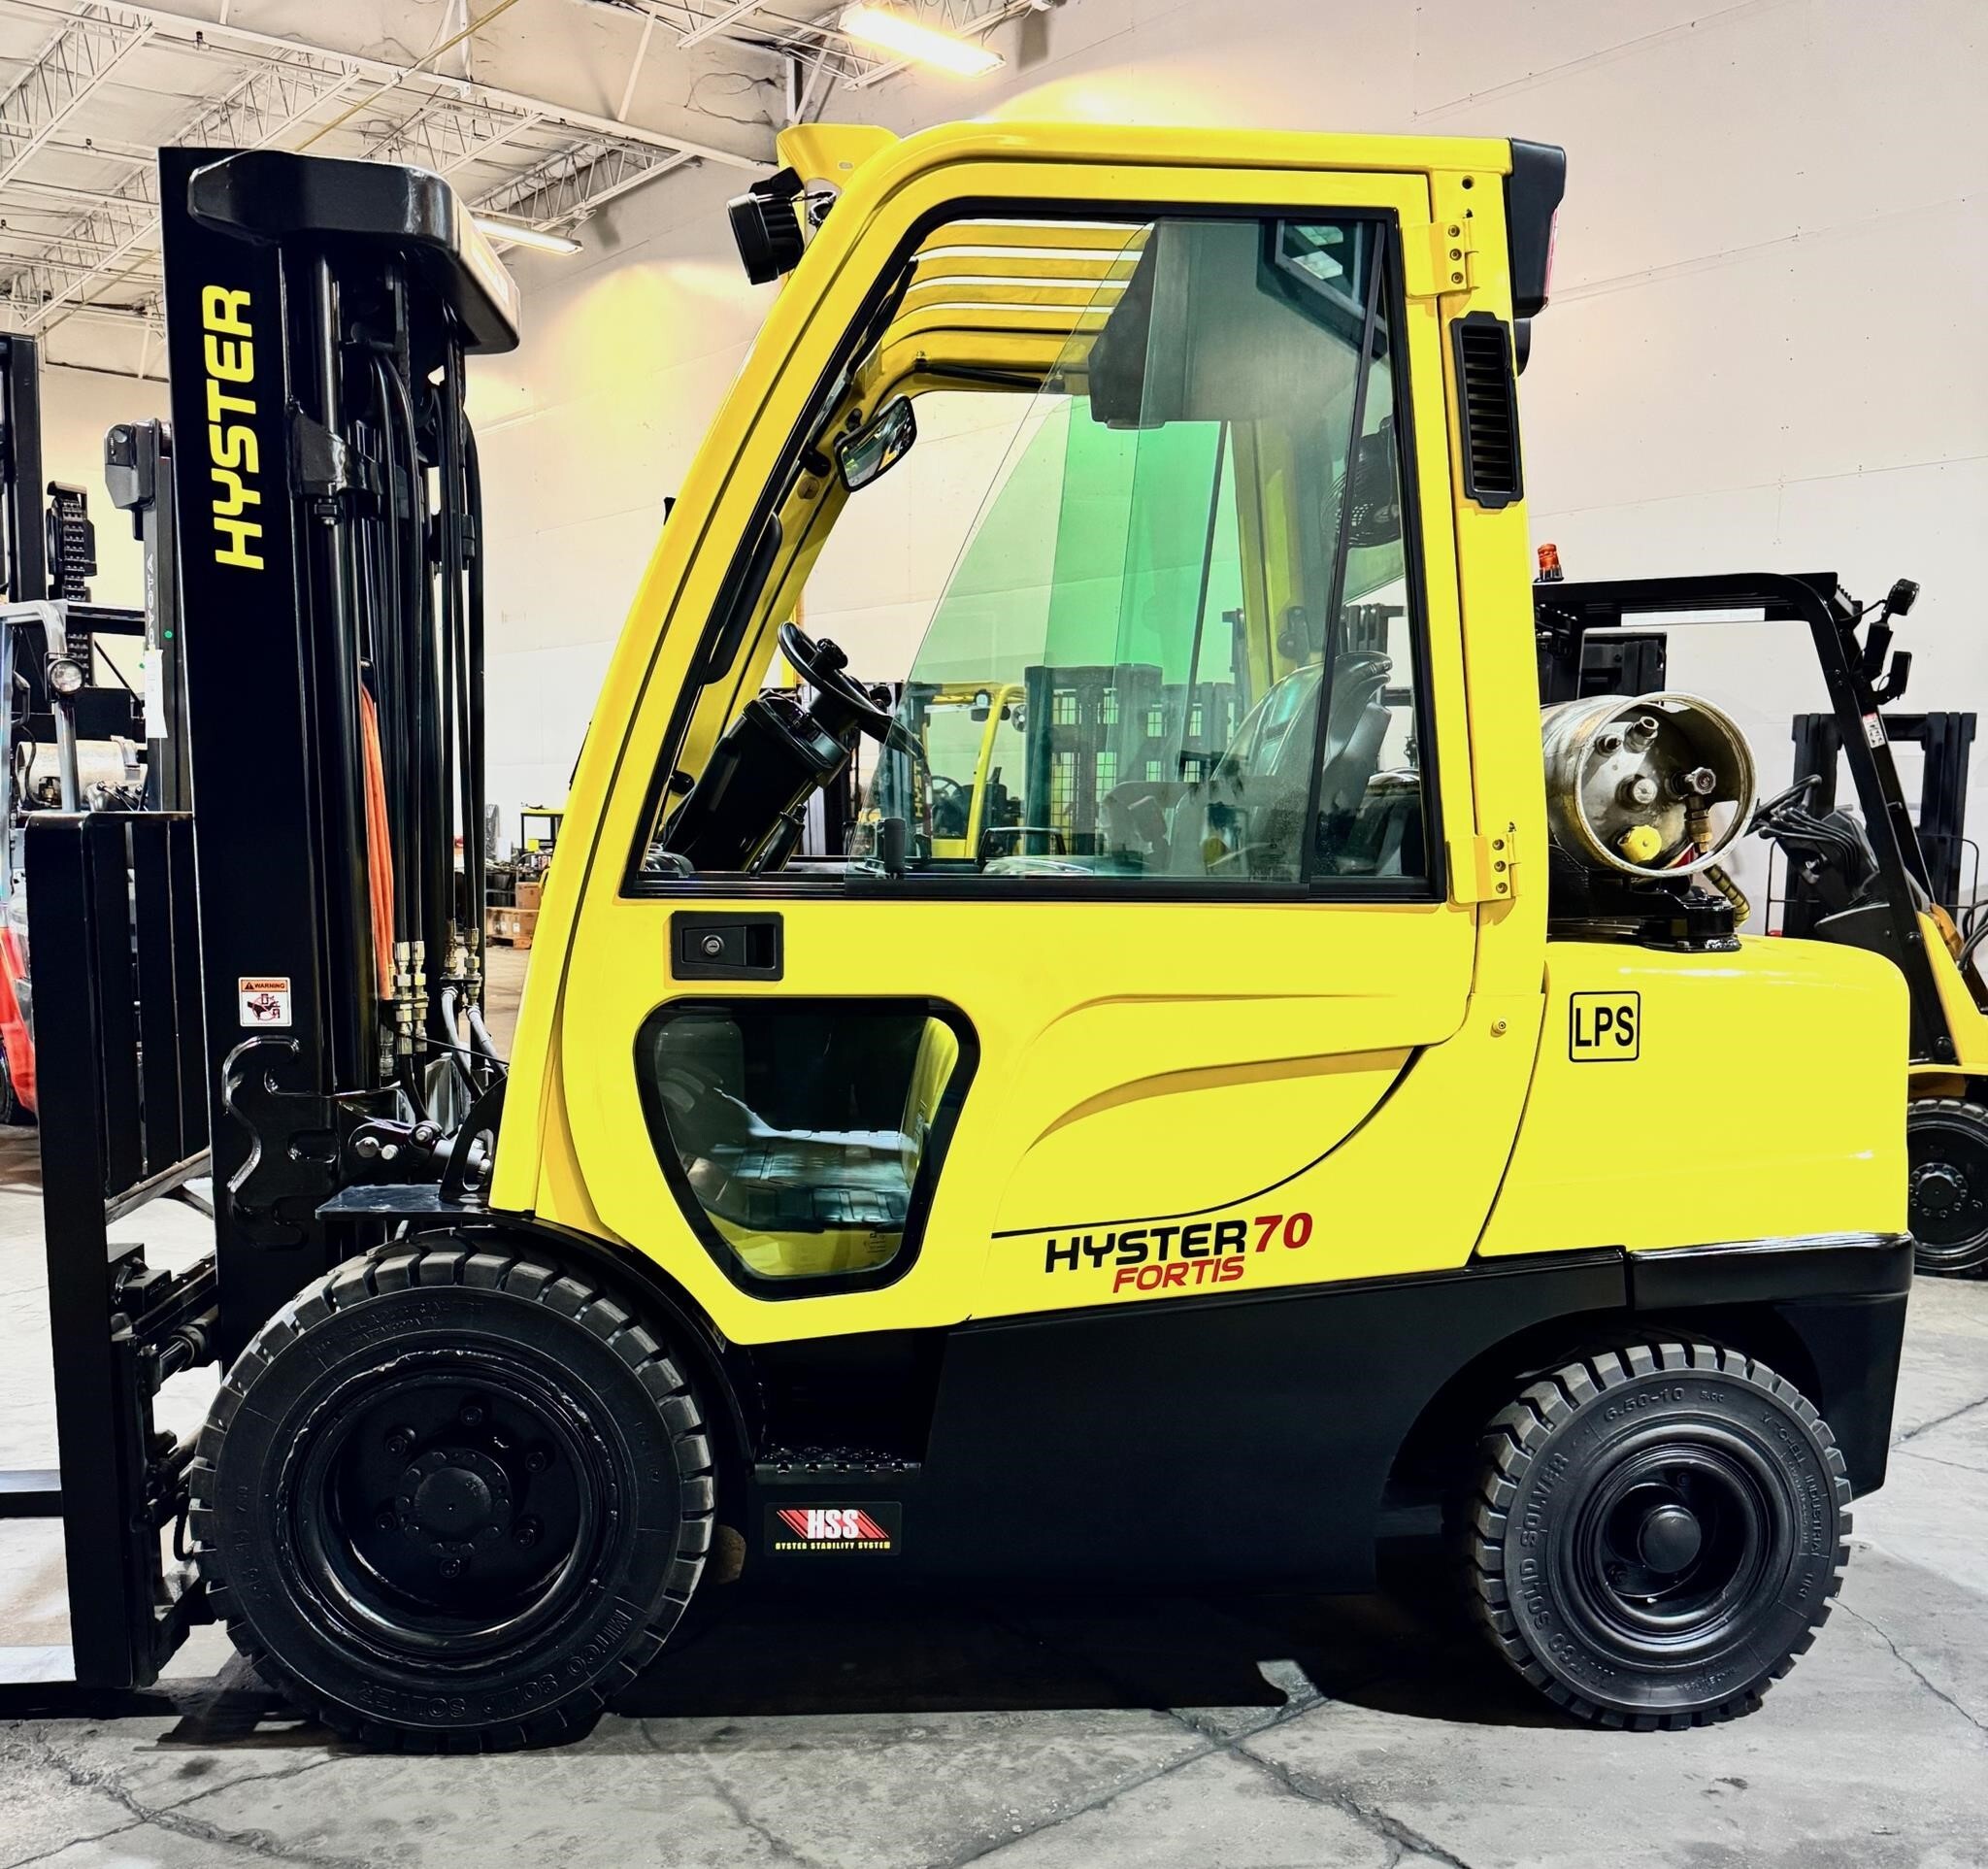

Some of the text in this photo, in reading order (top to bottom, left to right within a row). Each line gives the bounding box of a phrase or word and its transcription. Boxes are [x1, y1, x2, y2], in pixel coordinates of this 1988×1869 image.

[202, 284, 264, 570] HYSTER
[1575, 1006, 1634, 1046] LPS
[1044, 1212, 1313, 1274] HYSTER 70
[1112, 1256, 1244, 1293] FORTIS
[1604, 1386, 1685, 1421] 6.50-10
[807, 1509, 860, 1539] HSS
[858, 1541, 890, 1550] SYSTEM
[1519, 1557, 1552, 1629] SOLID
